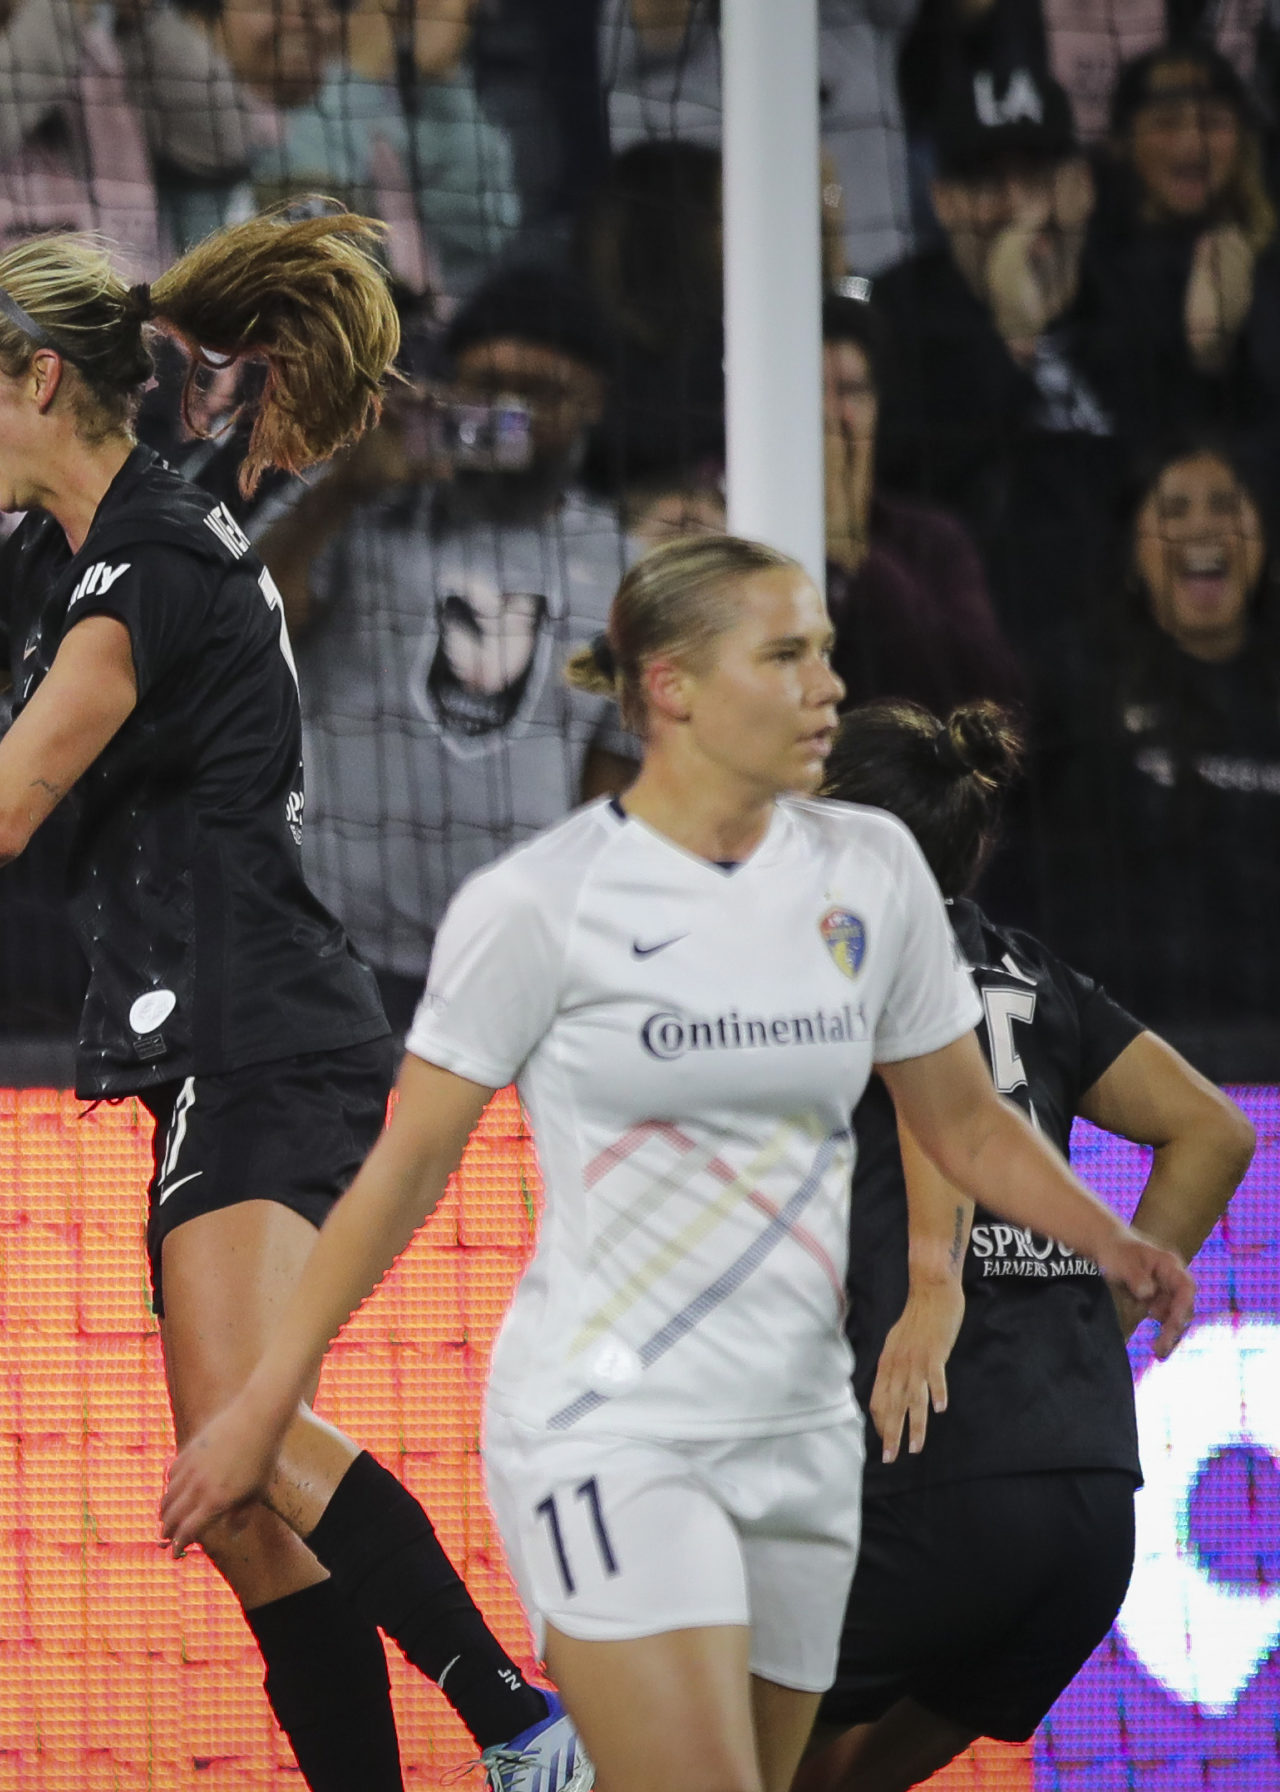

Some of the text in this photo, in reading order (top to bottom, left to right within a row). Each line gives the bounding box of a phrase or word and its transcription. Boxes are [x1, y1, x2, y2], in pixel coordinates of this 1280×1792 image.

[973, 69, 1042, 126] LA
[643, 1001, 856, 1060] Continental
[983, 1260, 1048, 1277] FARMERS
[536, 1475, 617, 1594] 11
